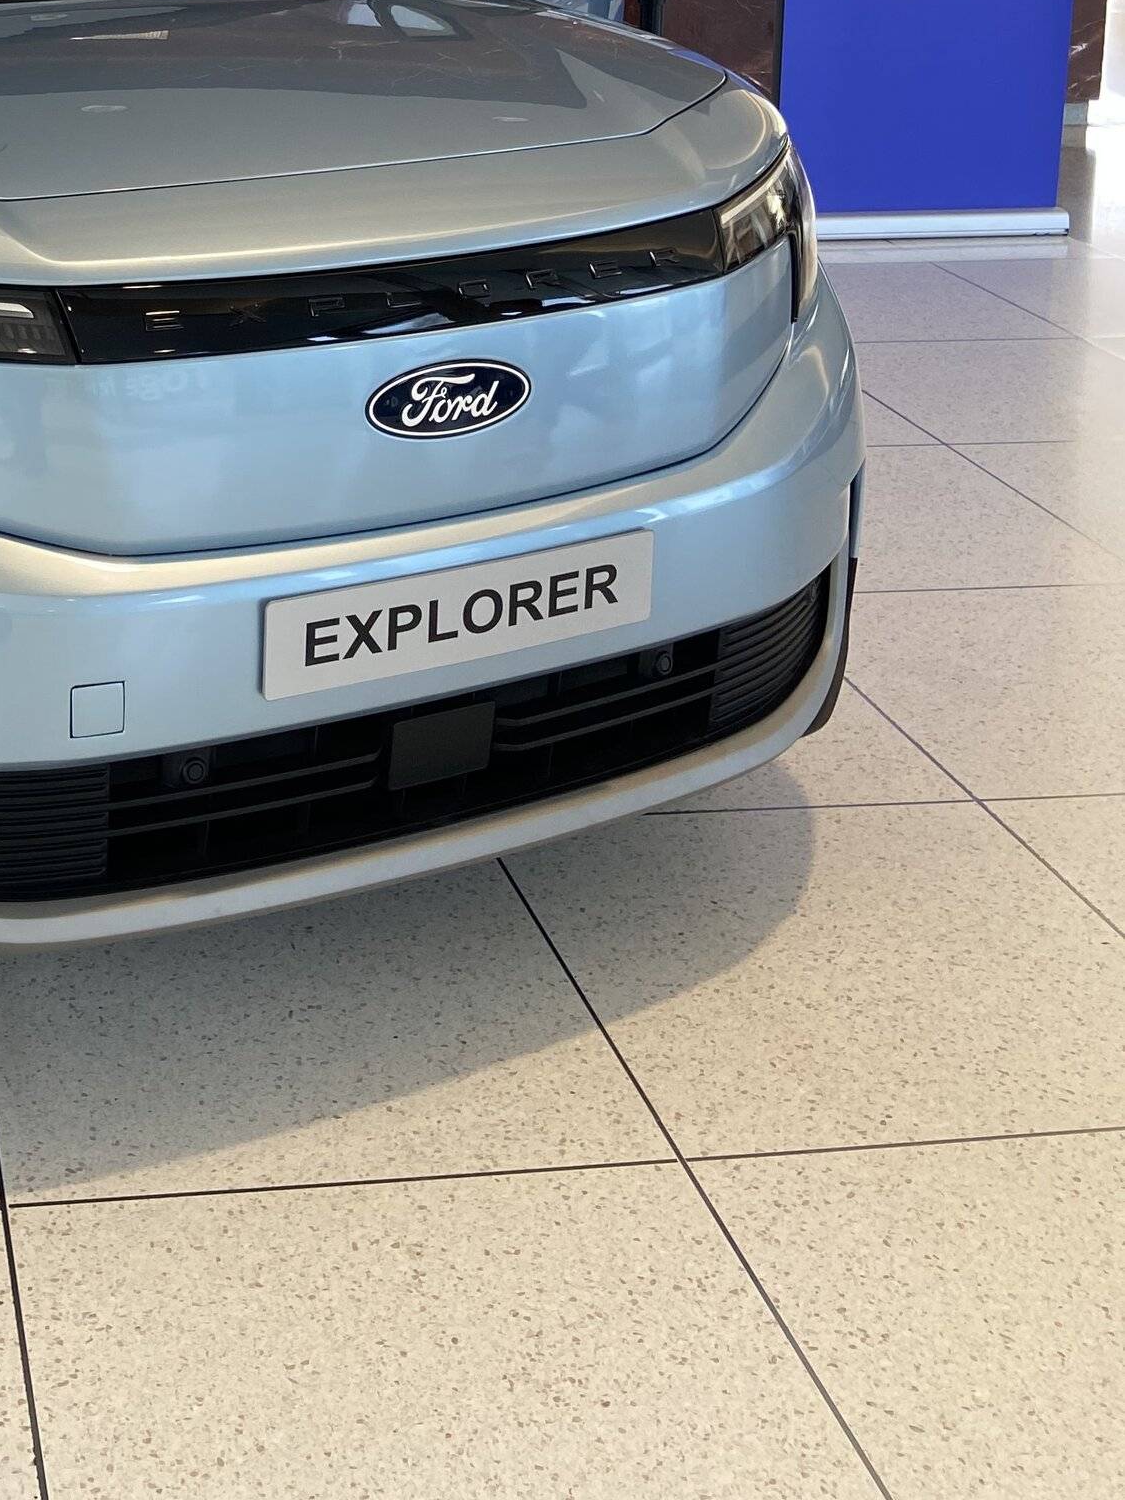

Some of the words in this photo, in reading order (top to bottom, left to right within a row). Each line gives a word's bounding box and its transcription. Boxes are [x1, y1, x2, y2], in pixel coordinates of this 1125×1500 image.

[144, 248, 680, 332] EXPLORER
[402, 373, 500, 427] Ford
[304, 564, 619, 667] EXPLORER
